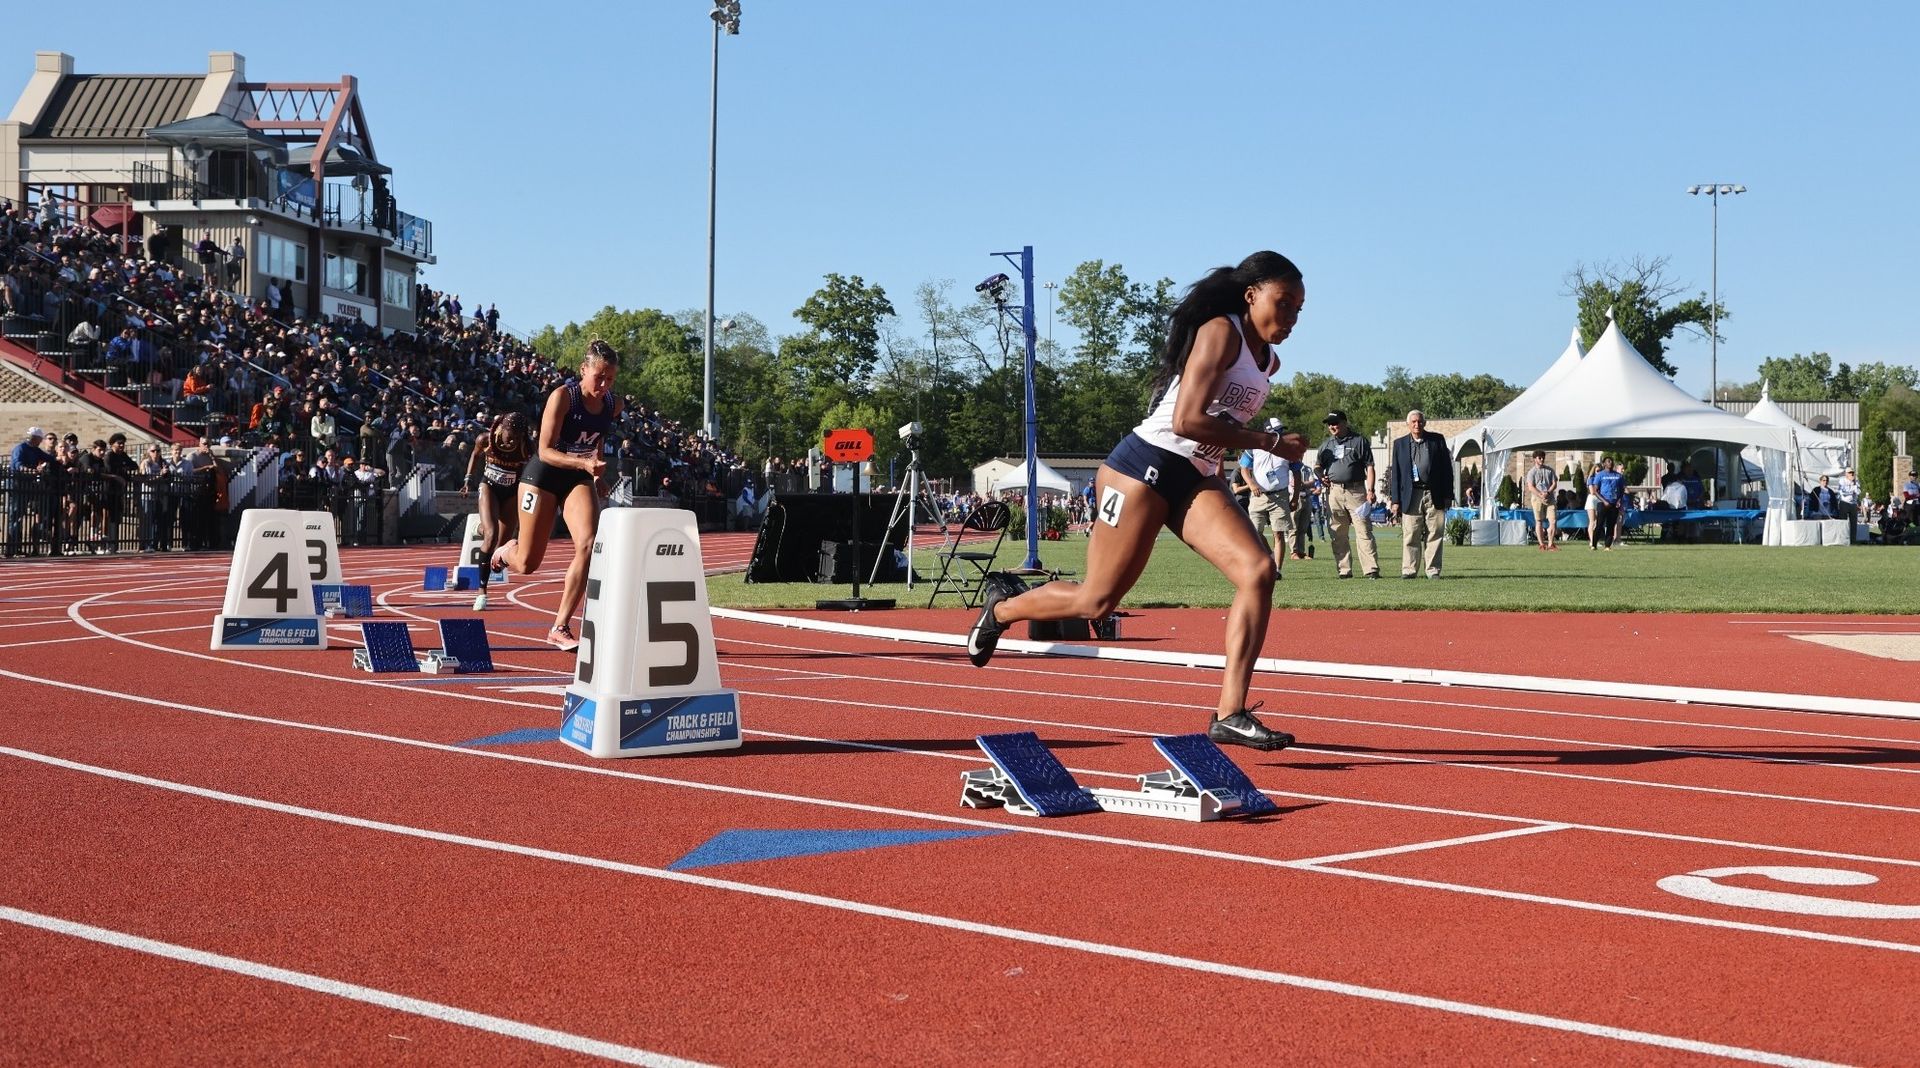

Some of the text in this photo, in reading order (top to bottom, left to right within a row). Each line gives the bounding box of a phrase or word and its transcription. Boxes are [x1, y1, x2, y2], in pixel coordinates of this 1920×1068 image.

[834, 441, 863, 450] GILL
[523, 492, 534, 511] 3
[1102, 492, 1119, 523] 4
[262, 530, 286, 538] GILL
[656, 544, 685, 556] GILL
[305, 539, 328, 581] 3
[247, 552, 298, 613] 4
[260, 628, 317, 638] TRACK & FIELD
[646, 581, 700, 687] 5
[667, 711, 734, 730] TRACK & FIELD
[666, 727, 721, 742] CHAMPIONSHIPS
